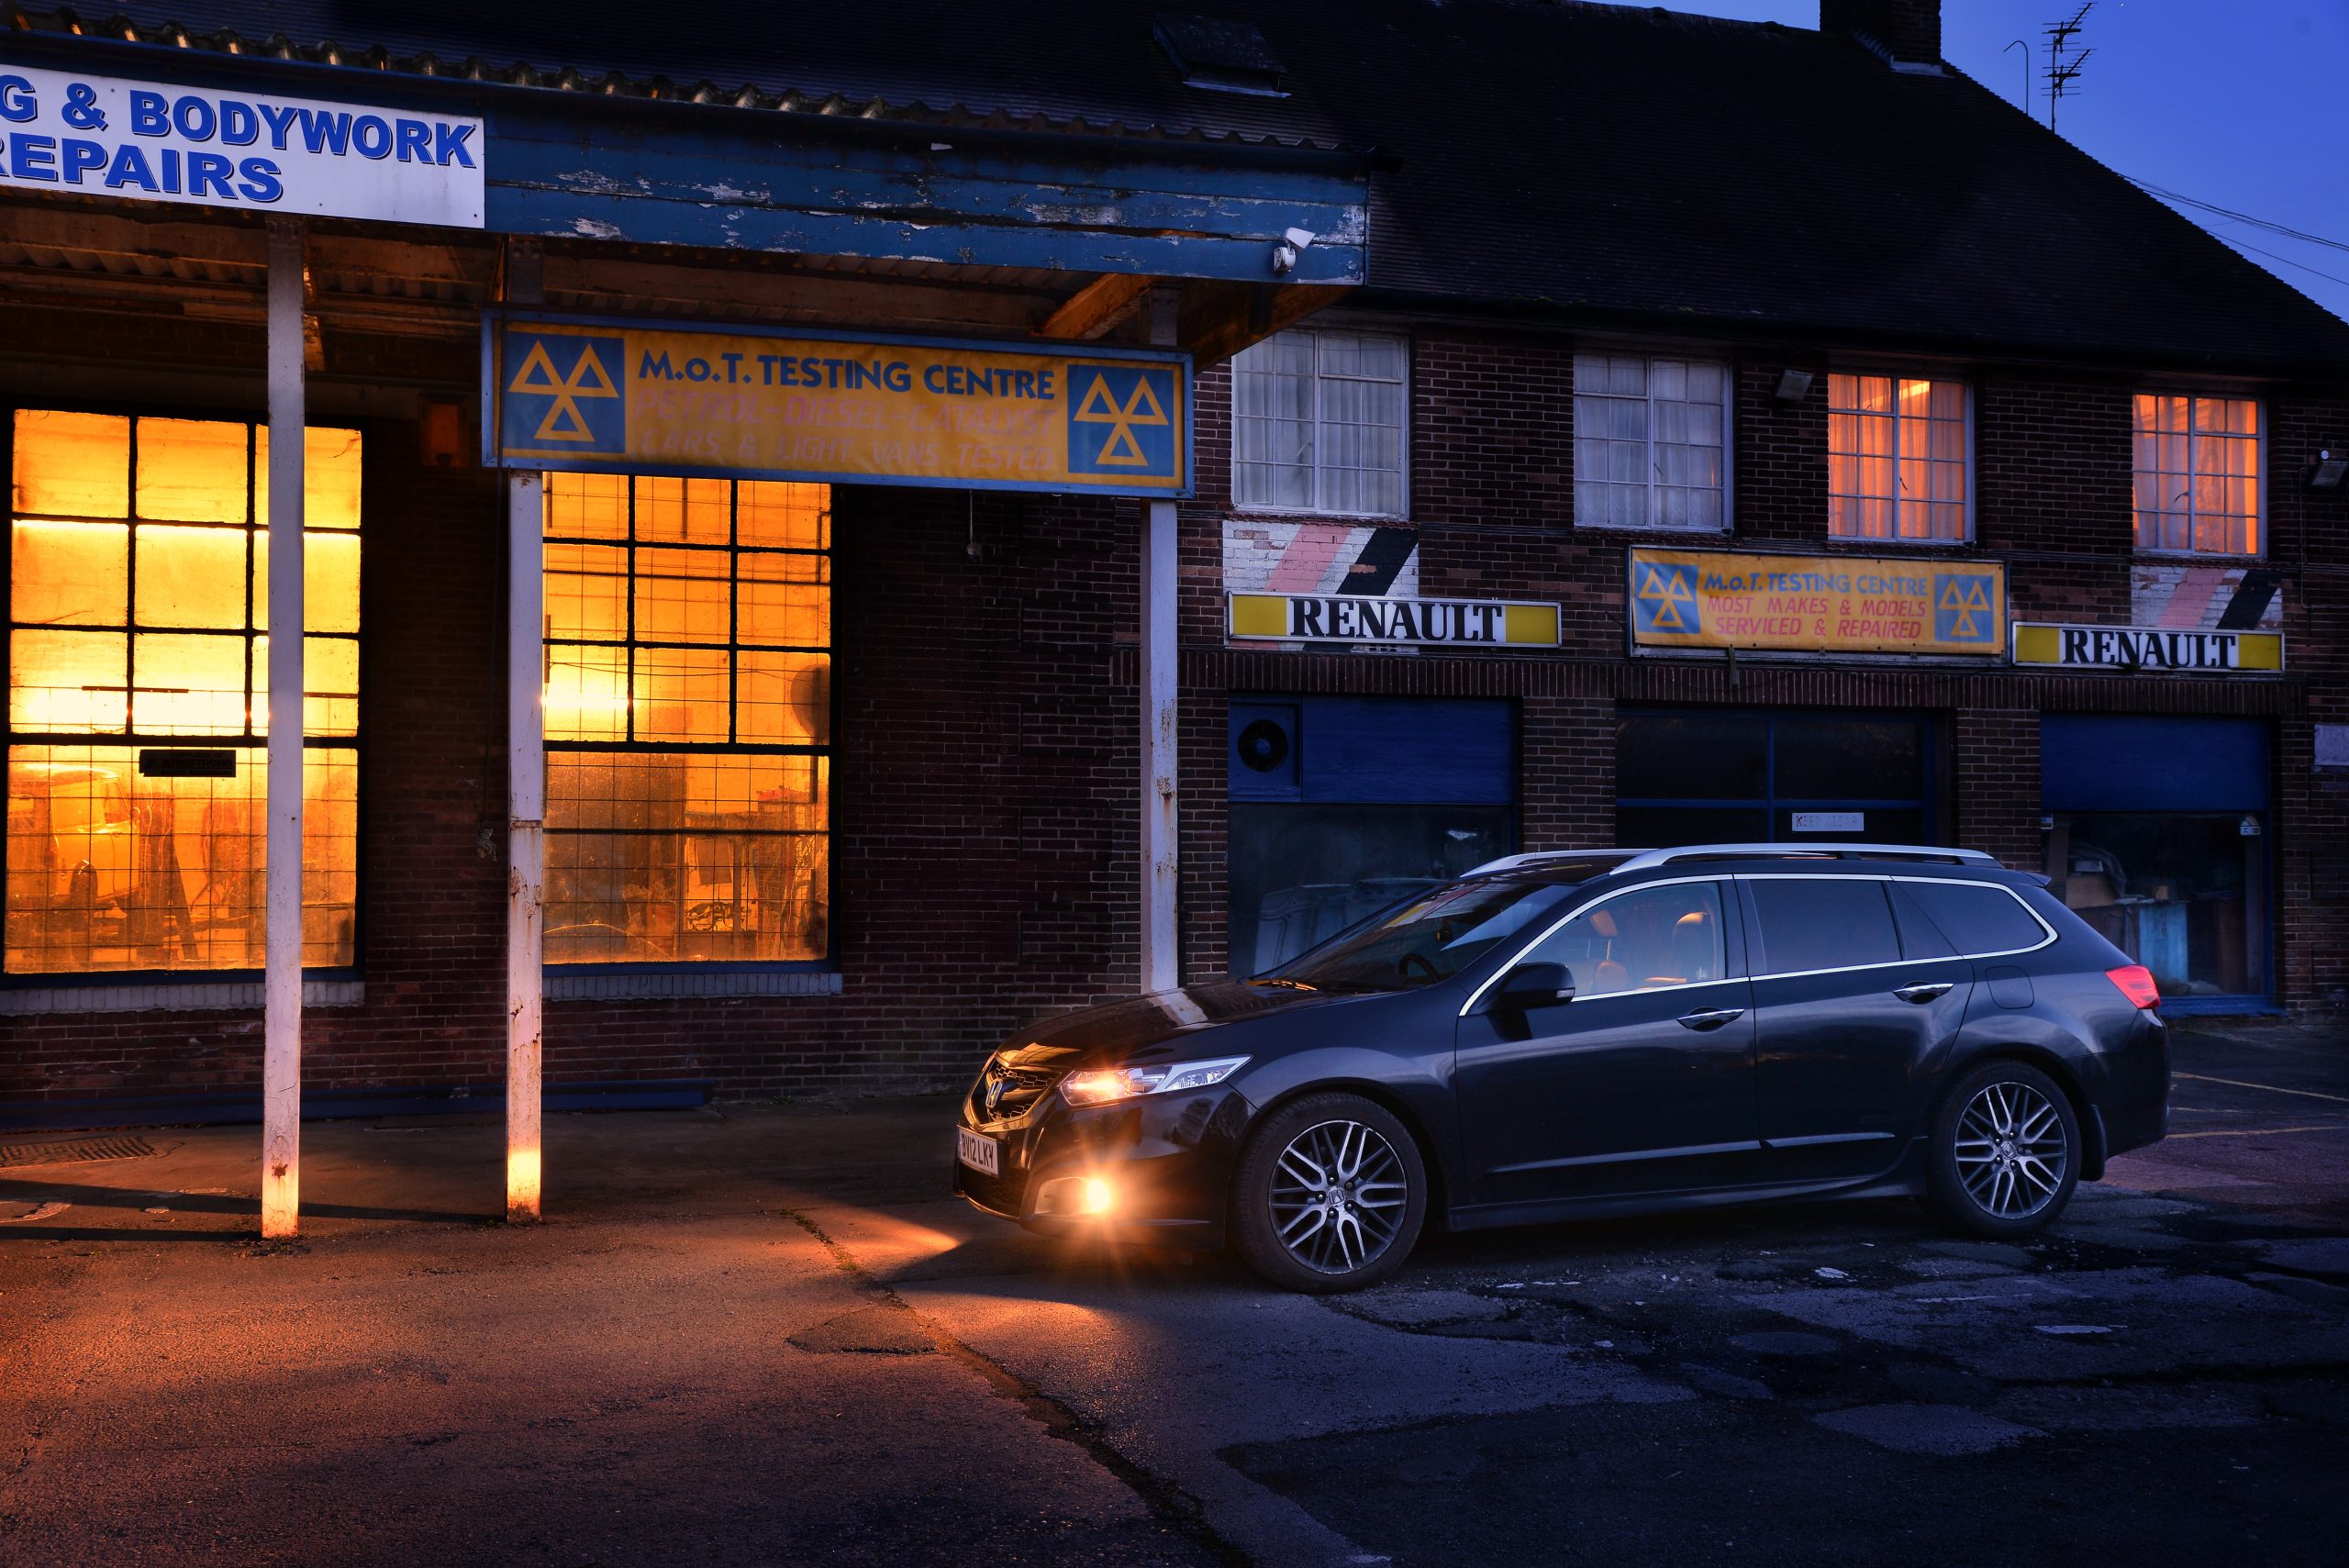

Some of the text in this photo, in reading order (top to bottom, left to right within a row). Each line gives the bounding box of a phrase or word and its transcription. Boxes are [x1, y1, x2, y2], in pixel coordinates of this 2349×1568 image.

[61, 83, 108, 132] &
[129, 90, 477, 169] BODYWORK
[638, 349, 1055, 400] M.o.T. TESTING CENTRE
[640, 428, 1053, 472] CARS & LIGHT VANS TESTED
[1767, 573, 1851, 594] TESTING
[1856, 575, 1928, 597] CENTRE
[1289, 597, 1503, 642] RENAULT
[1706, 595, 1926, 617] MOST MAKES & MODELS
[1715, 617, 1921, 639] SERVICED & REPAIRED
[2062, 628, 2236, 669] RENAULT
[977, 1140, 994, 1169] LKY
